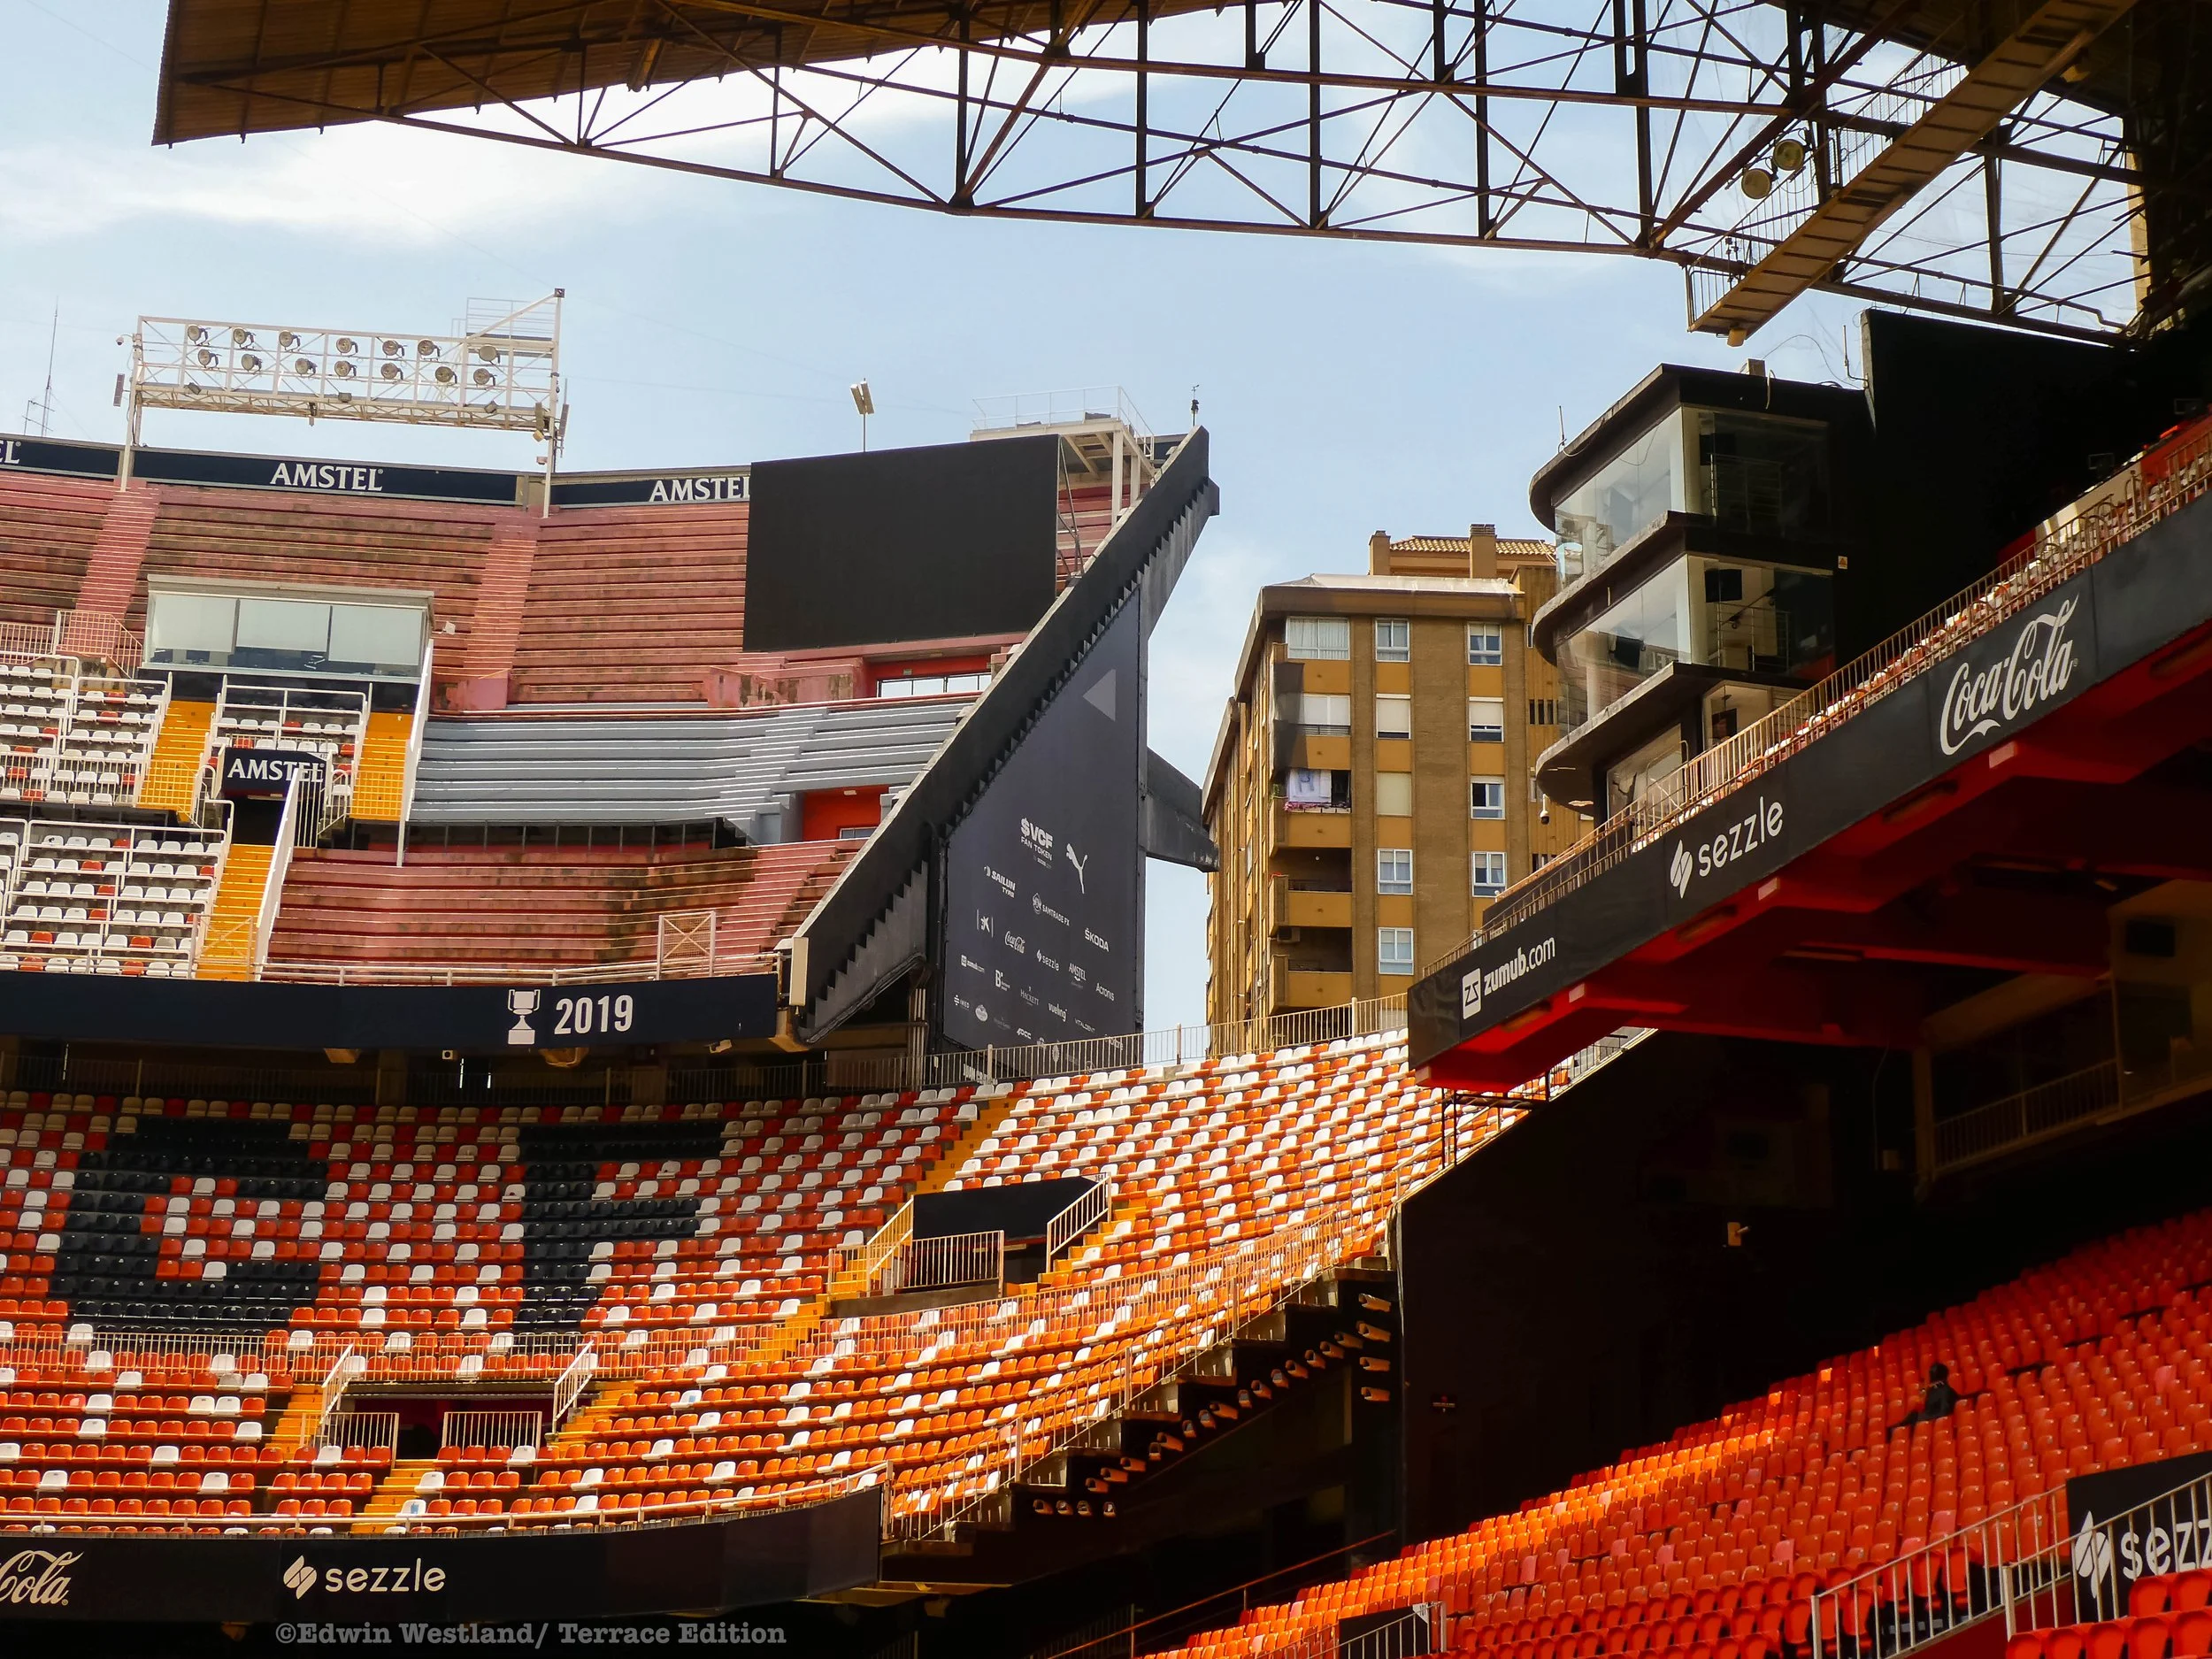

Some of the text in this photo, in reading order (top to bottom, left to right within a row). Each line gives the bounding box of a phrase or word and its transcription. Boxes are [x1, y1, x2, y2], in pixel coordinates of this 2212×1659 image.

[270, 463, 383, 492] AMSTEL
[1939, 594, 2079, 756] Coca-Cola
[1020, 836, 1053, 861] FAN TOKEN
[1698, 795, 1784, 878] sezzle
[1484, 937, 1555, 996] zumub.com
[554, 995, 634, 1035] 2019
[325, 1557, 446, 1593] sezzle
